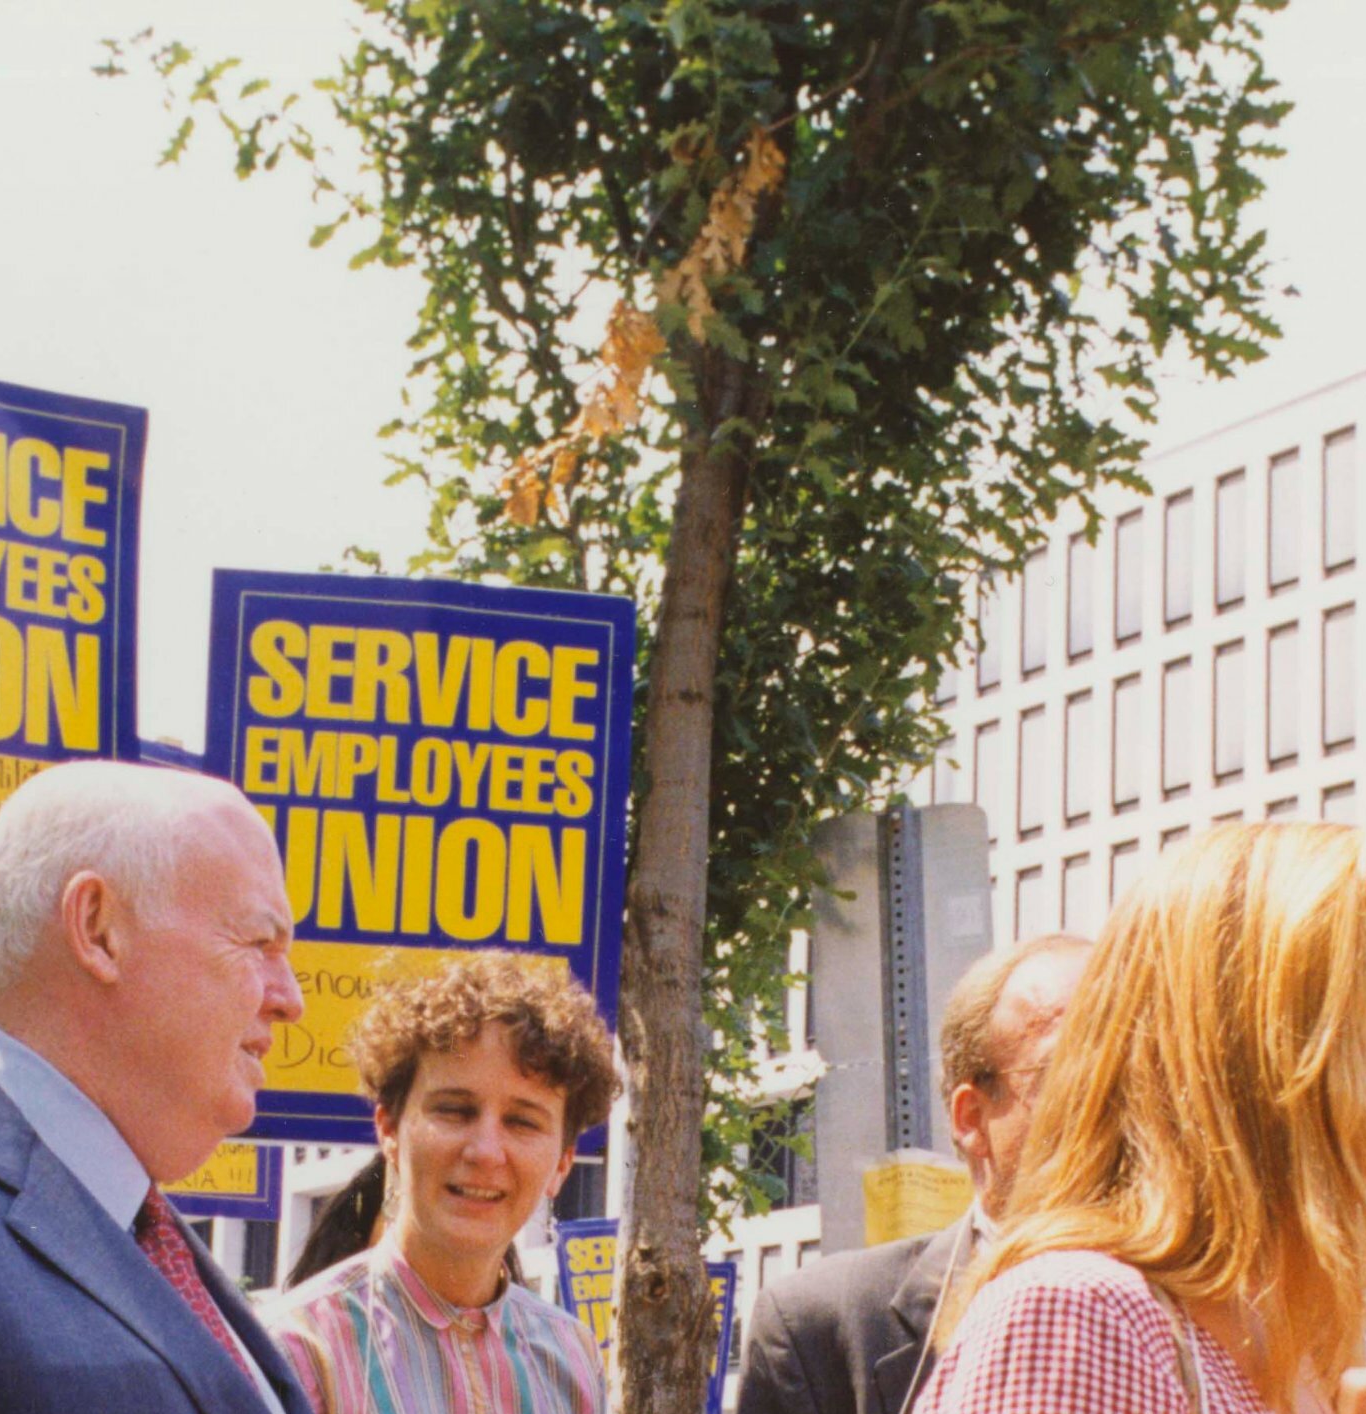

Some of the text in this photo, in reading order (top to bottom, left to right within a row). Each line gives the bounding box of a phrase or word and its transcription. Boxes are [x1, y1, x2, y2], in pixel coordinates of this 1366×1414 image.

[247, 620, 599, 741] SERVICE
[244, 726, 595, 818] EMPLOYEES
[252, 804, 587, 945] UNION
